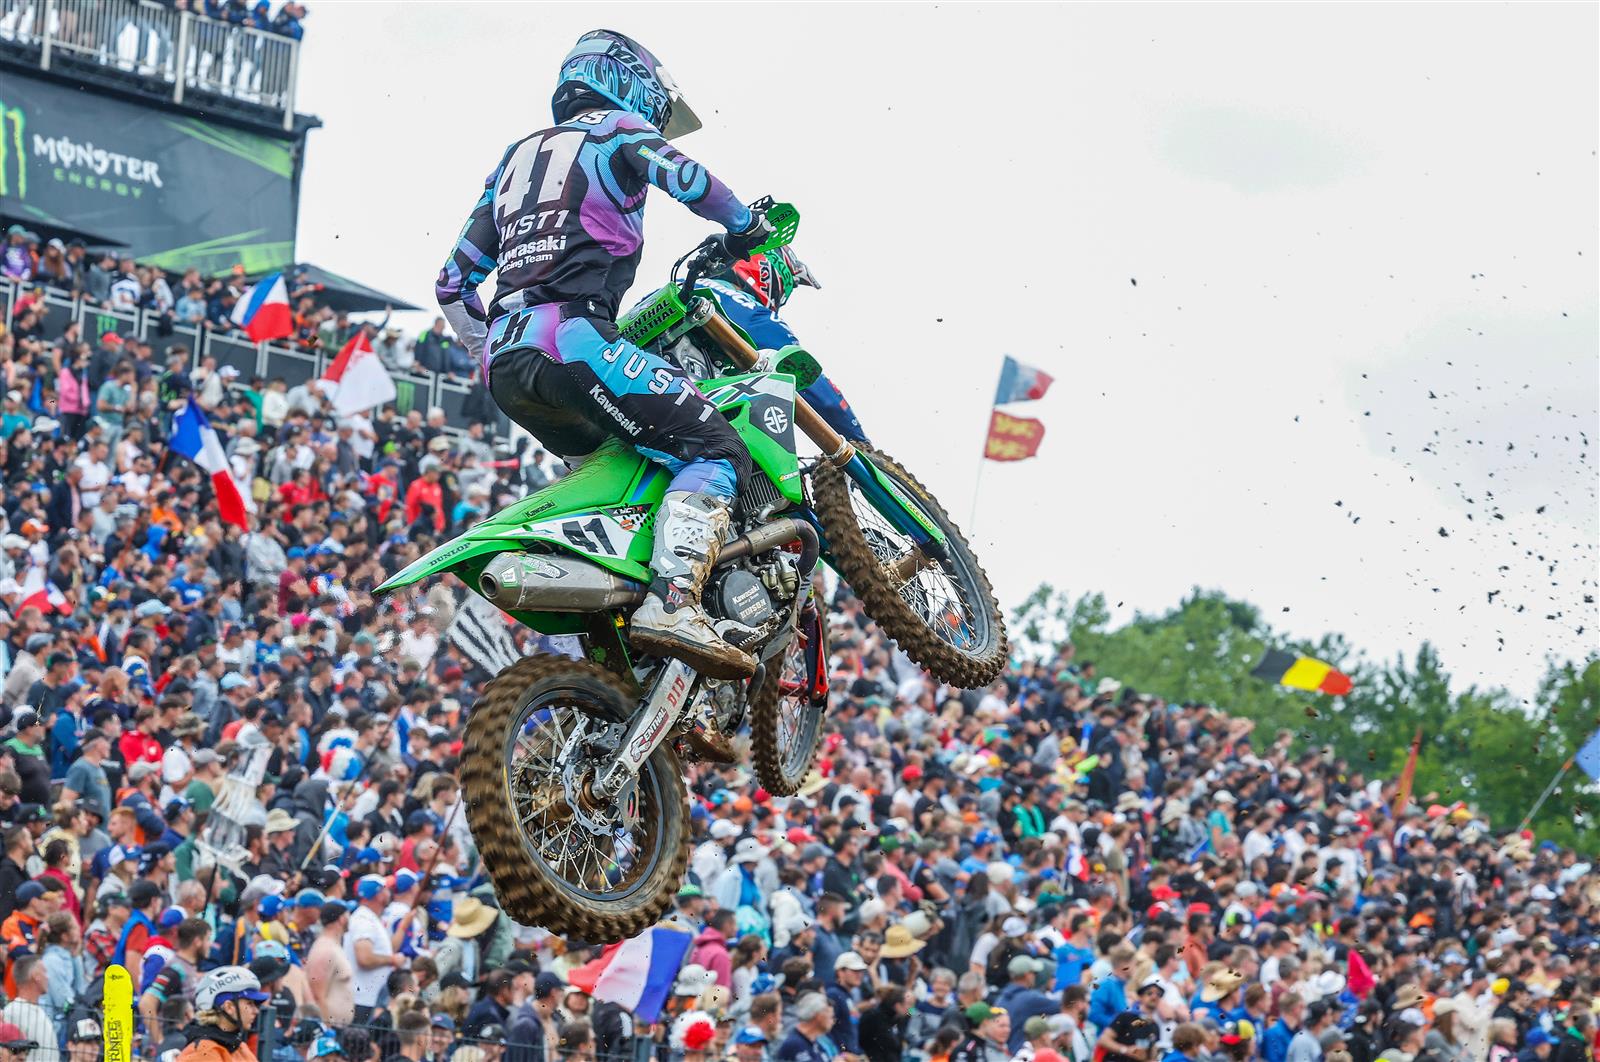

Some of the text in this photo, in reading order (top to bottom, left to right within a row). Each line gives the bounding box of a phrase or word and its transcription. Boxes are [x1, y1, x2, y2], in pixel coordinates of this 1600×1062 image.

[33, 133, 163, 188] MONSTER
[496, 131, 589, 219] 41
[53, 168, 144, 199] ENERGY
[525, 253, 553, 265] Team
[589, 383, 644, 438] Kawasaki
[525, 501, 556, 518] Kawasaki
[562, 518, 618, 556] 41
[428, 542, 472, 567] DUNLOP
[630, 706, 670, 763] RENTHAL
[207, 974, 242, 996] AIROH
